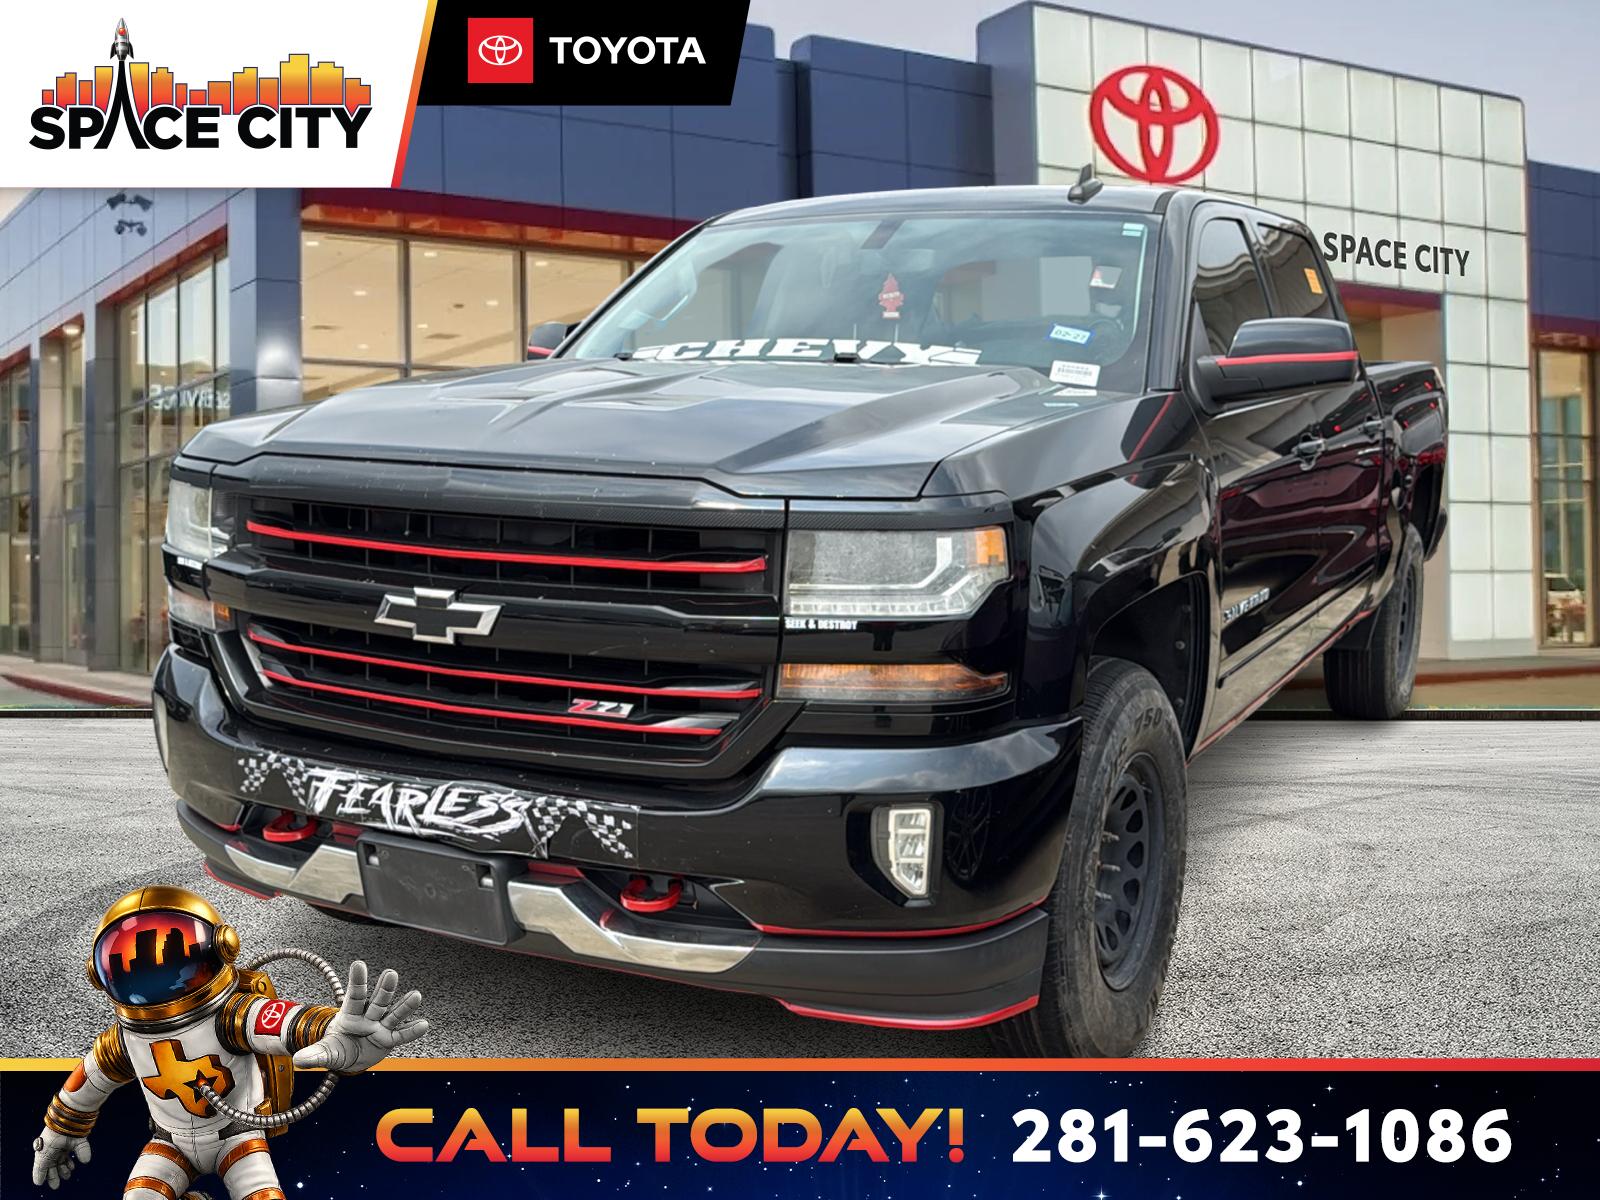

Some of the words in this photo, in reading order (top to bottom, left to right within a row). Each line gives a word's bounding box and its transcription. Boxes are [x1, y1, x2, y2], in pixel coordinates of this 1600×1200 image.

[1323, 232, 1407, 269] SPACE
[1414, 244, 1470, 277] CITY
[632, 337, 982, 365] CHEVY
[785, 619, 806, 629] SEEK
[808, 619, 816, 629] &
[818, 620, 858, 630] DESTROY
[567, 698, 634, 719] Z71
[304, 767, 533, 836] FEARLESS
